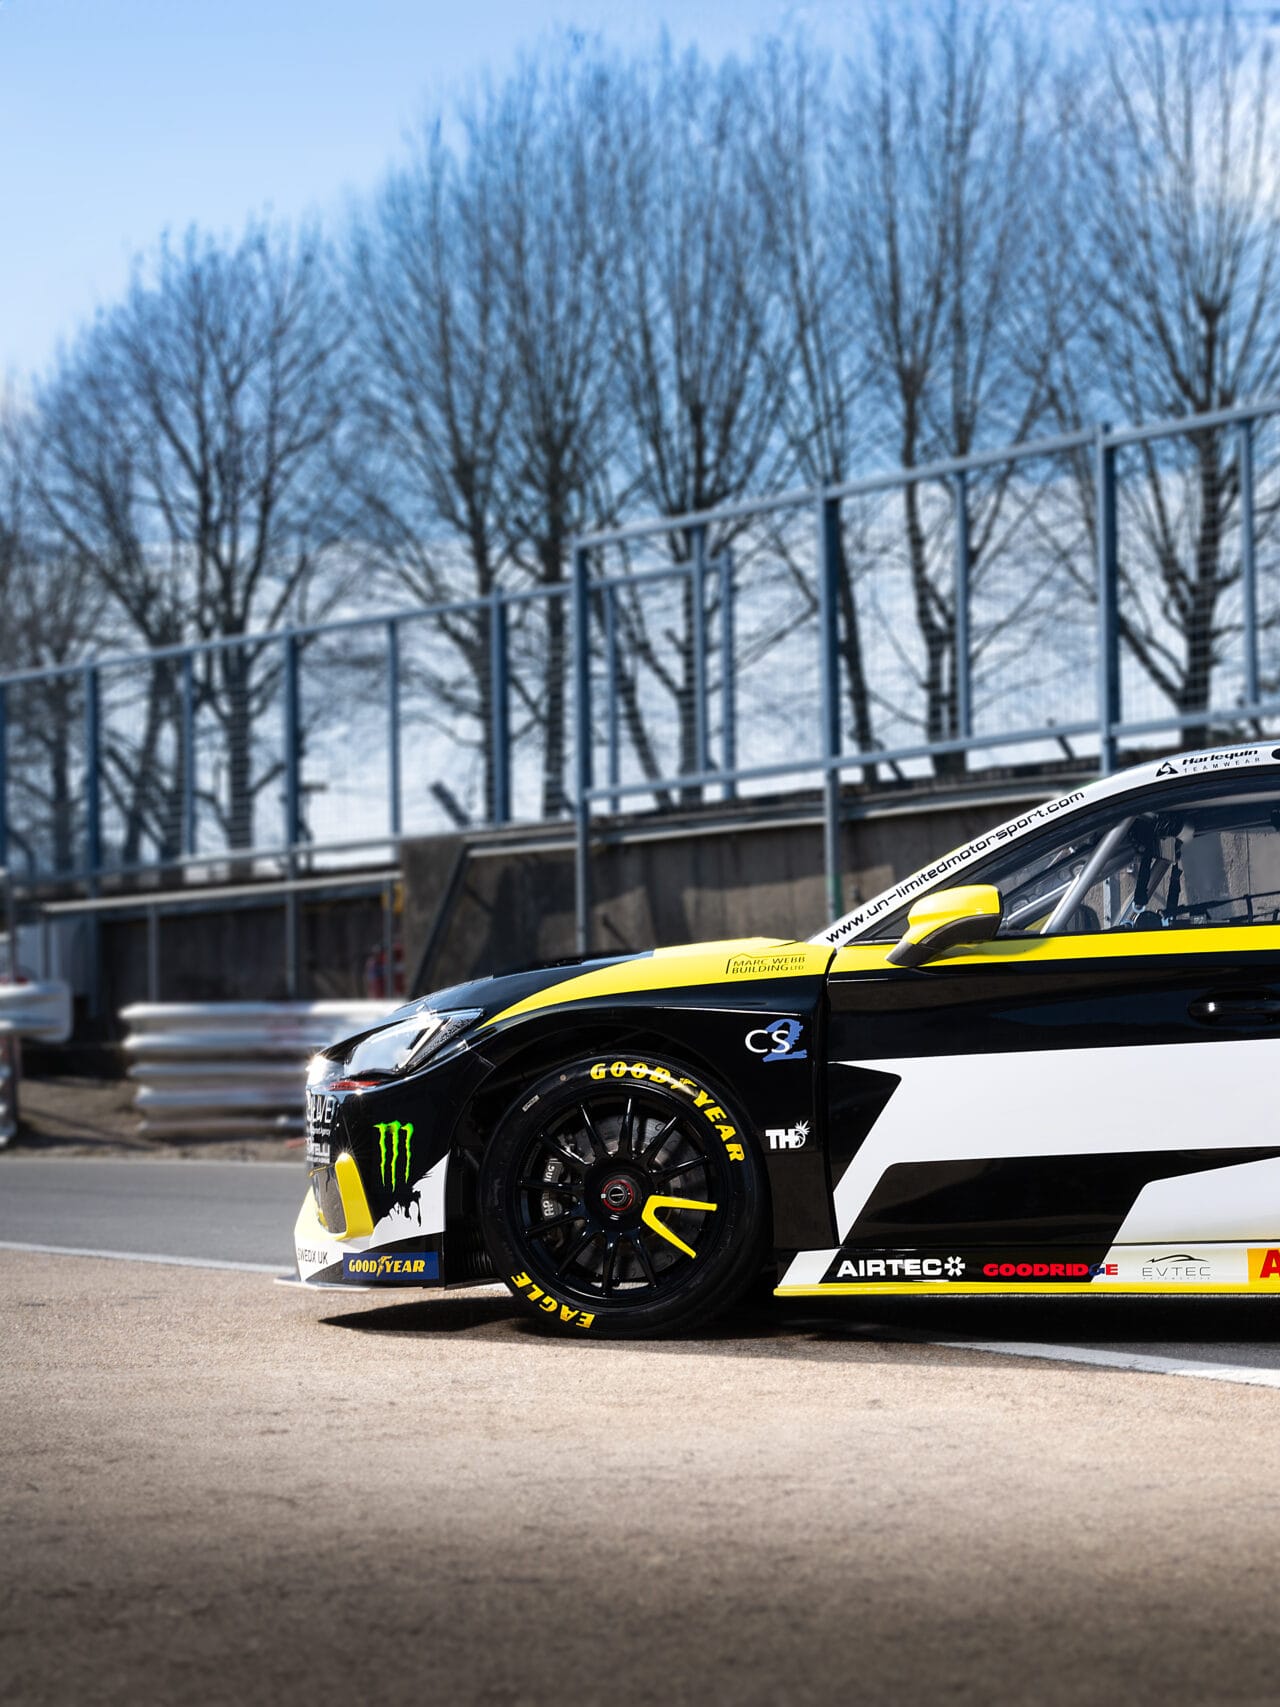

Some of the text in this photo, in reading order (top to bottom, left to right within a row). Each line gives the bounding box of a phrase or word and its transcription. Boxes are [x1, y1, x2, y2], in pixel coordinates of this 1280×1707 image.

[1182, 750, 1259, 766] Harlequin
[1184, 757, 1260, 774] TEAMWEAR
[825, 791, 1085, 944] www.un-limitedmotorsport.com
[731, 964, 789, 974] BUILDING
[733, 956, 806, 967] MARC WEBB
[836, 1258, 943, 1278] AIRTEC
[982, 1262, 1119, 1278] GOODRIDGE
[1142, 1266, 1211, 1277] EVTEC
[511, 1271, 598, 1329] EAGLE
